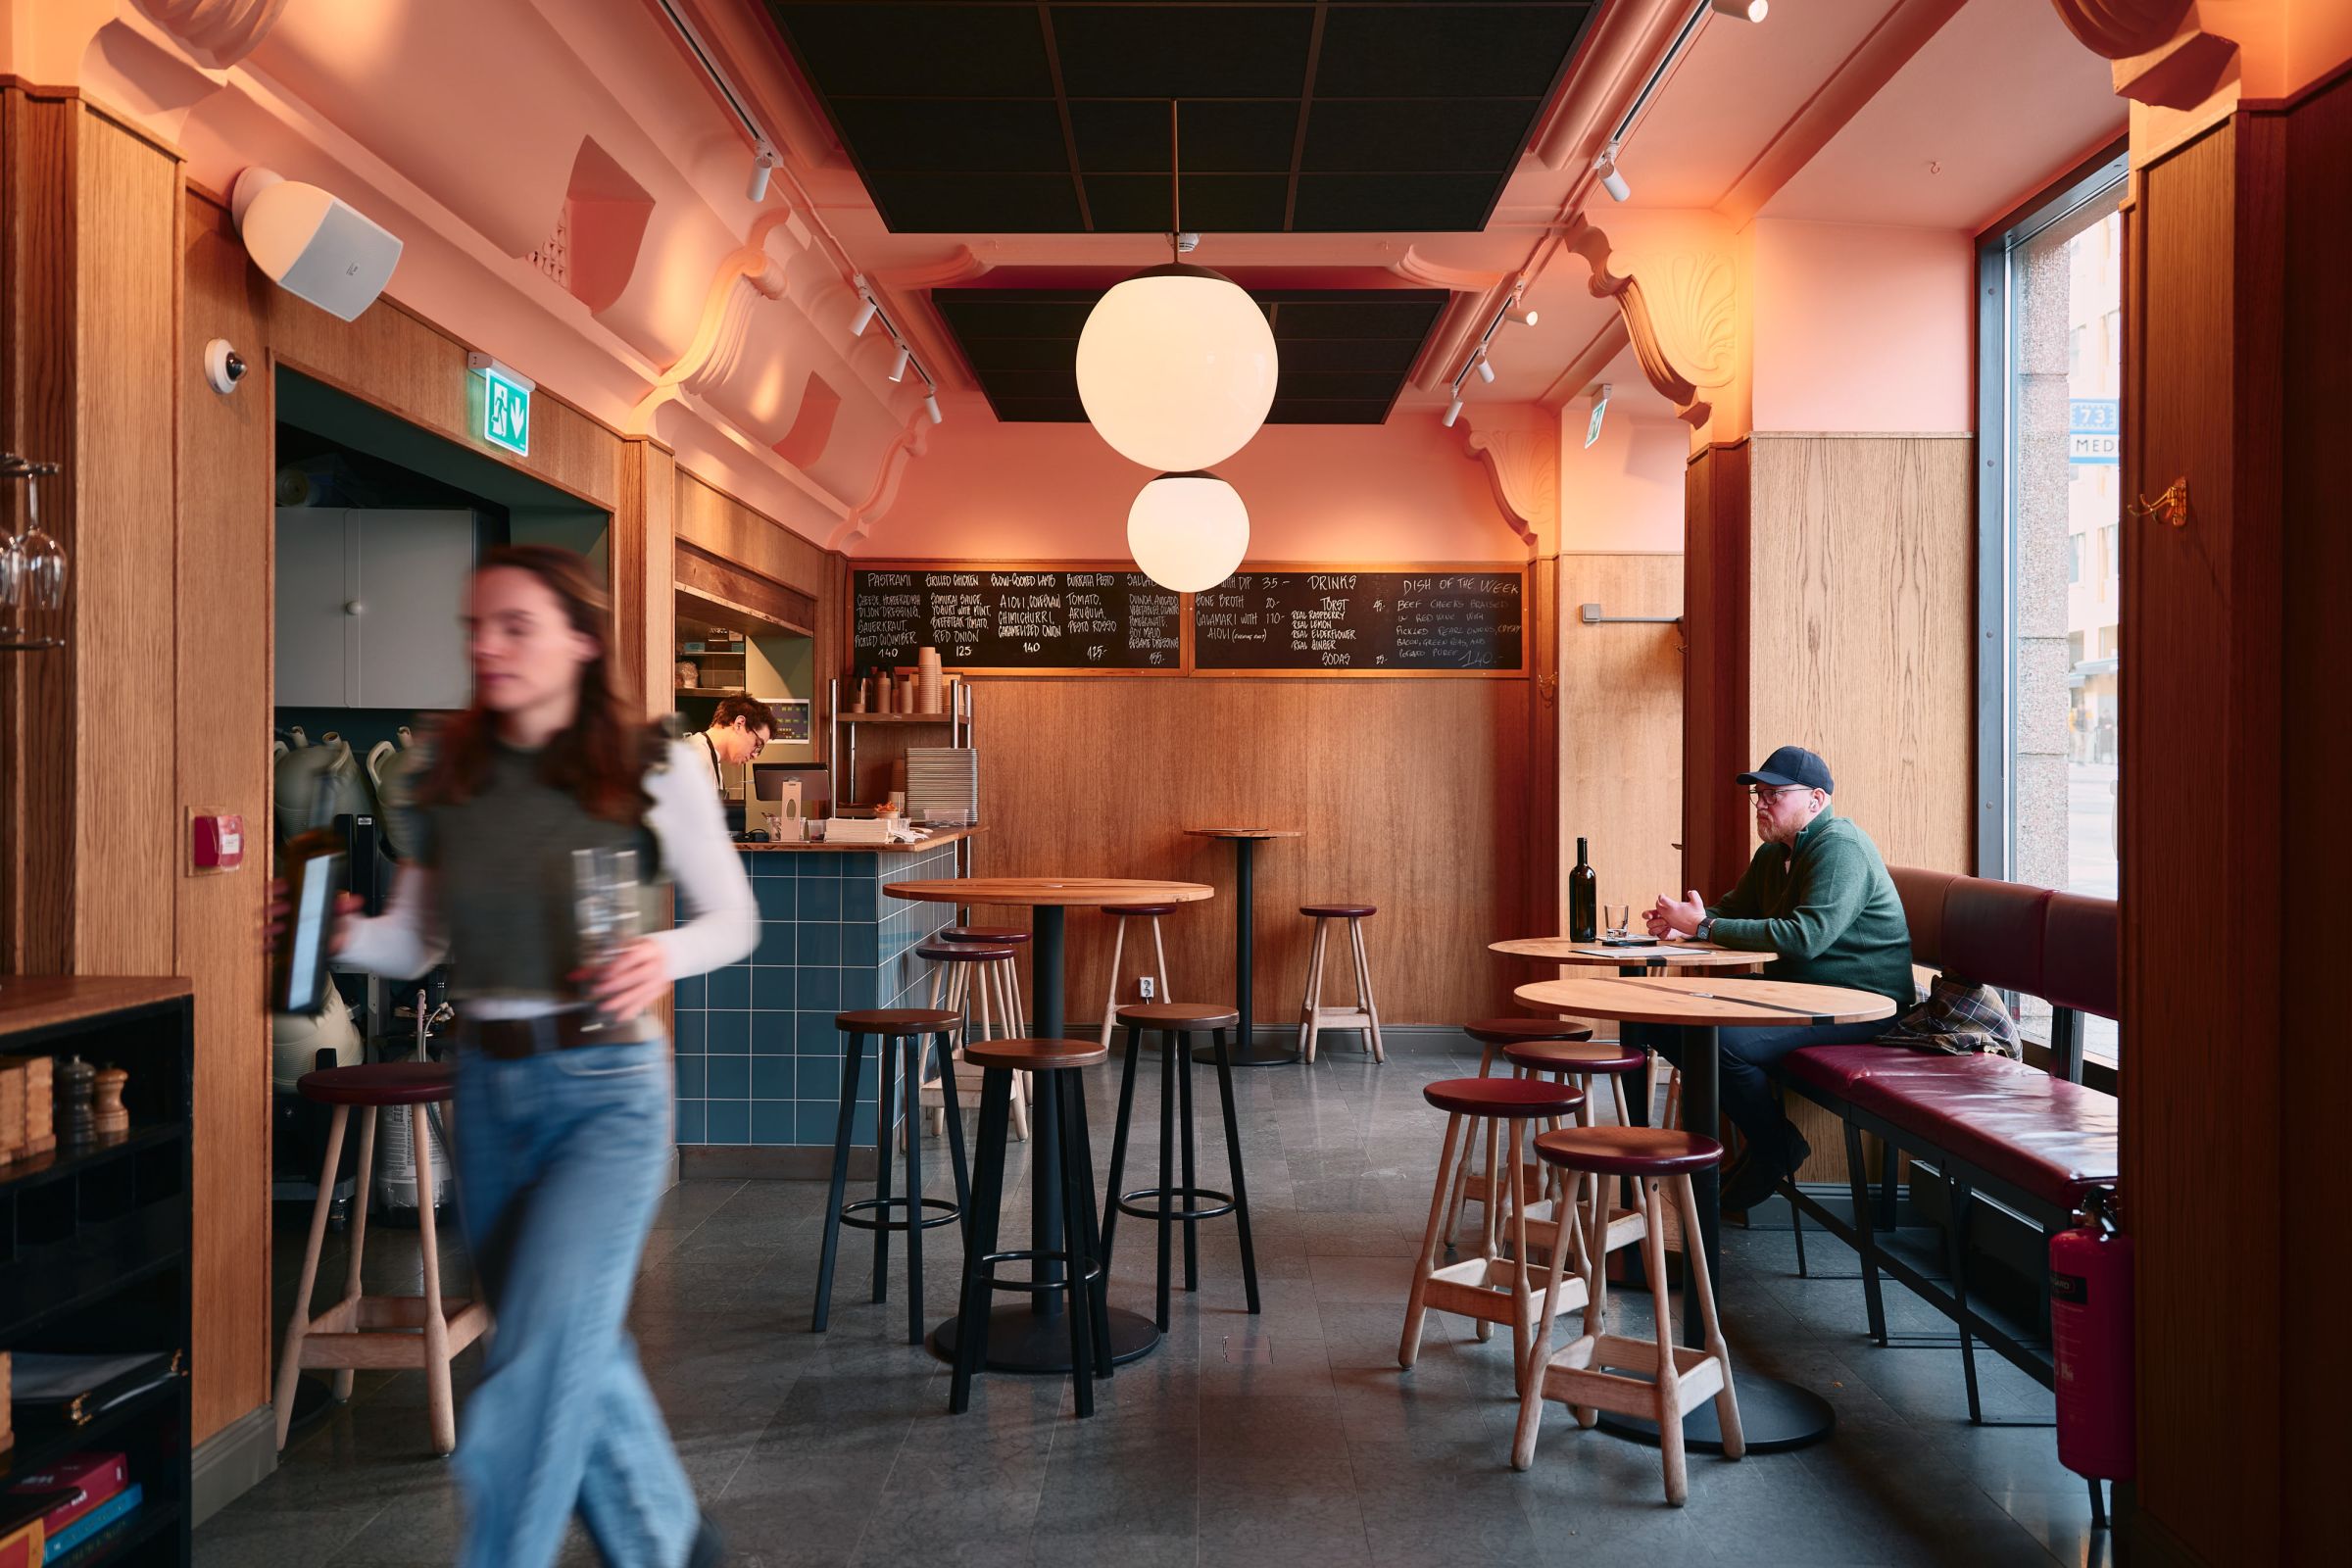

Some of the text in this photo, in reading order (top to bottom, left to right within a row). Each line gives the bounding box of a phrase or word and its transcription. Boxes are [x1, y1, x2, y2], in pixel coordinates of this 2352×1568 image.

[2080, 408, 2106, 424] 73
[2076, 439, 2115, 453] MED
[868, 572, 911, 587] PASTRAMI
[925, 572, 979, 587] GRILLED CHICKEN
[991, 572, 1056, 587] SLOW-COOKED LAMB
[1066, 573, 1115, 587] BURRATA PESTO
[1238, 576, 1252, 590] DIP
[1306, 574, 1357, 590] DRINKS
[1403, 577, 1519, 596] DISH OF THE WEEK
[1195, 593, 1215, 607] BONE
[1219, 593, 1245, 608] BROTH
[1397, 599, 1509, 611] BEEF CHEEKS BRAISED
[856, 607, 880, 617] DIJON
[1196, 610, 1237, 626] CALAMARI
[1240, 612, 1258, 625] WITH
[1291, 611, 1346, 620] REAL RASPBERRY
[1416, 613, 1434, 622] RED
[1466, 612, 1484, 621] WITH
[1067, 620, 1117, 634] PESTO ROSSO
[1291, 620, 1332, 629] REAL LEMON
[1396, 625, 1429, 635] PICKLED
[1438, 625, 1464, 636] PEARL
[933, 628, 980, 643] RED ONION
[1206, 627, 1230, 640] AIOLI
[1291, 629, 1357, 639] REAL ELDERFLOWER
[1023, 642, 1041, 654] 140
[1291, 639, 1337, 651] REAL GINGER
[878, 648, 899, 658] 140
[1322, 652, 1351, 666] SODAS
